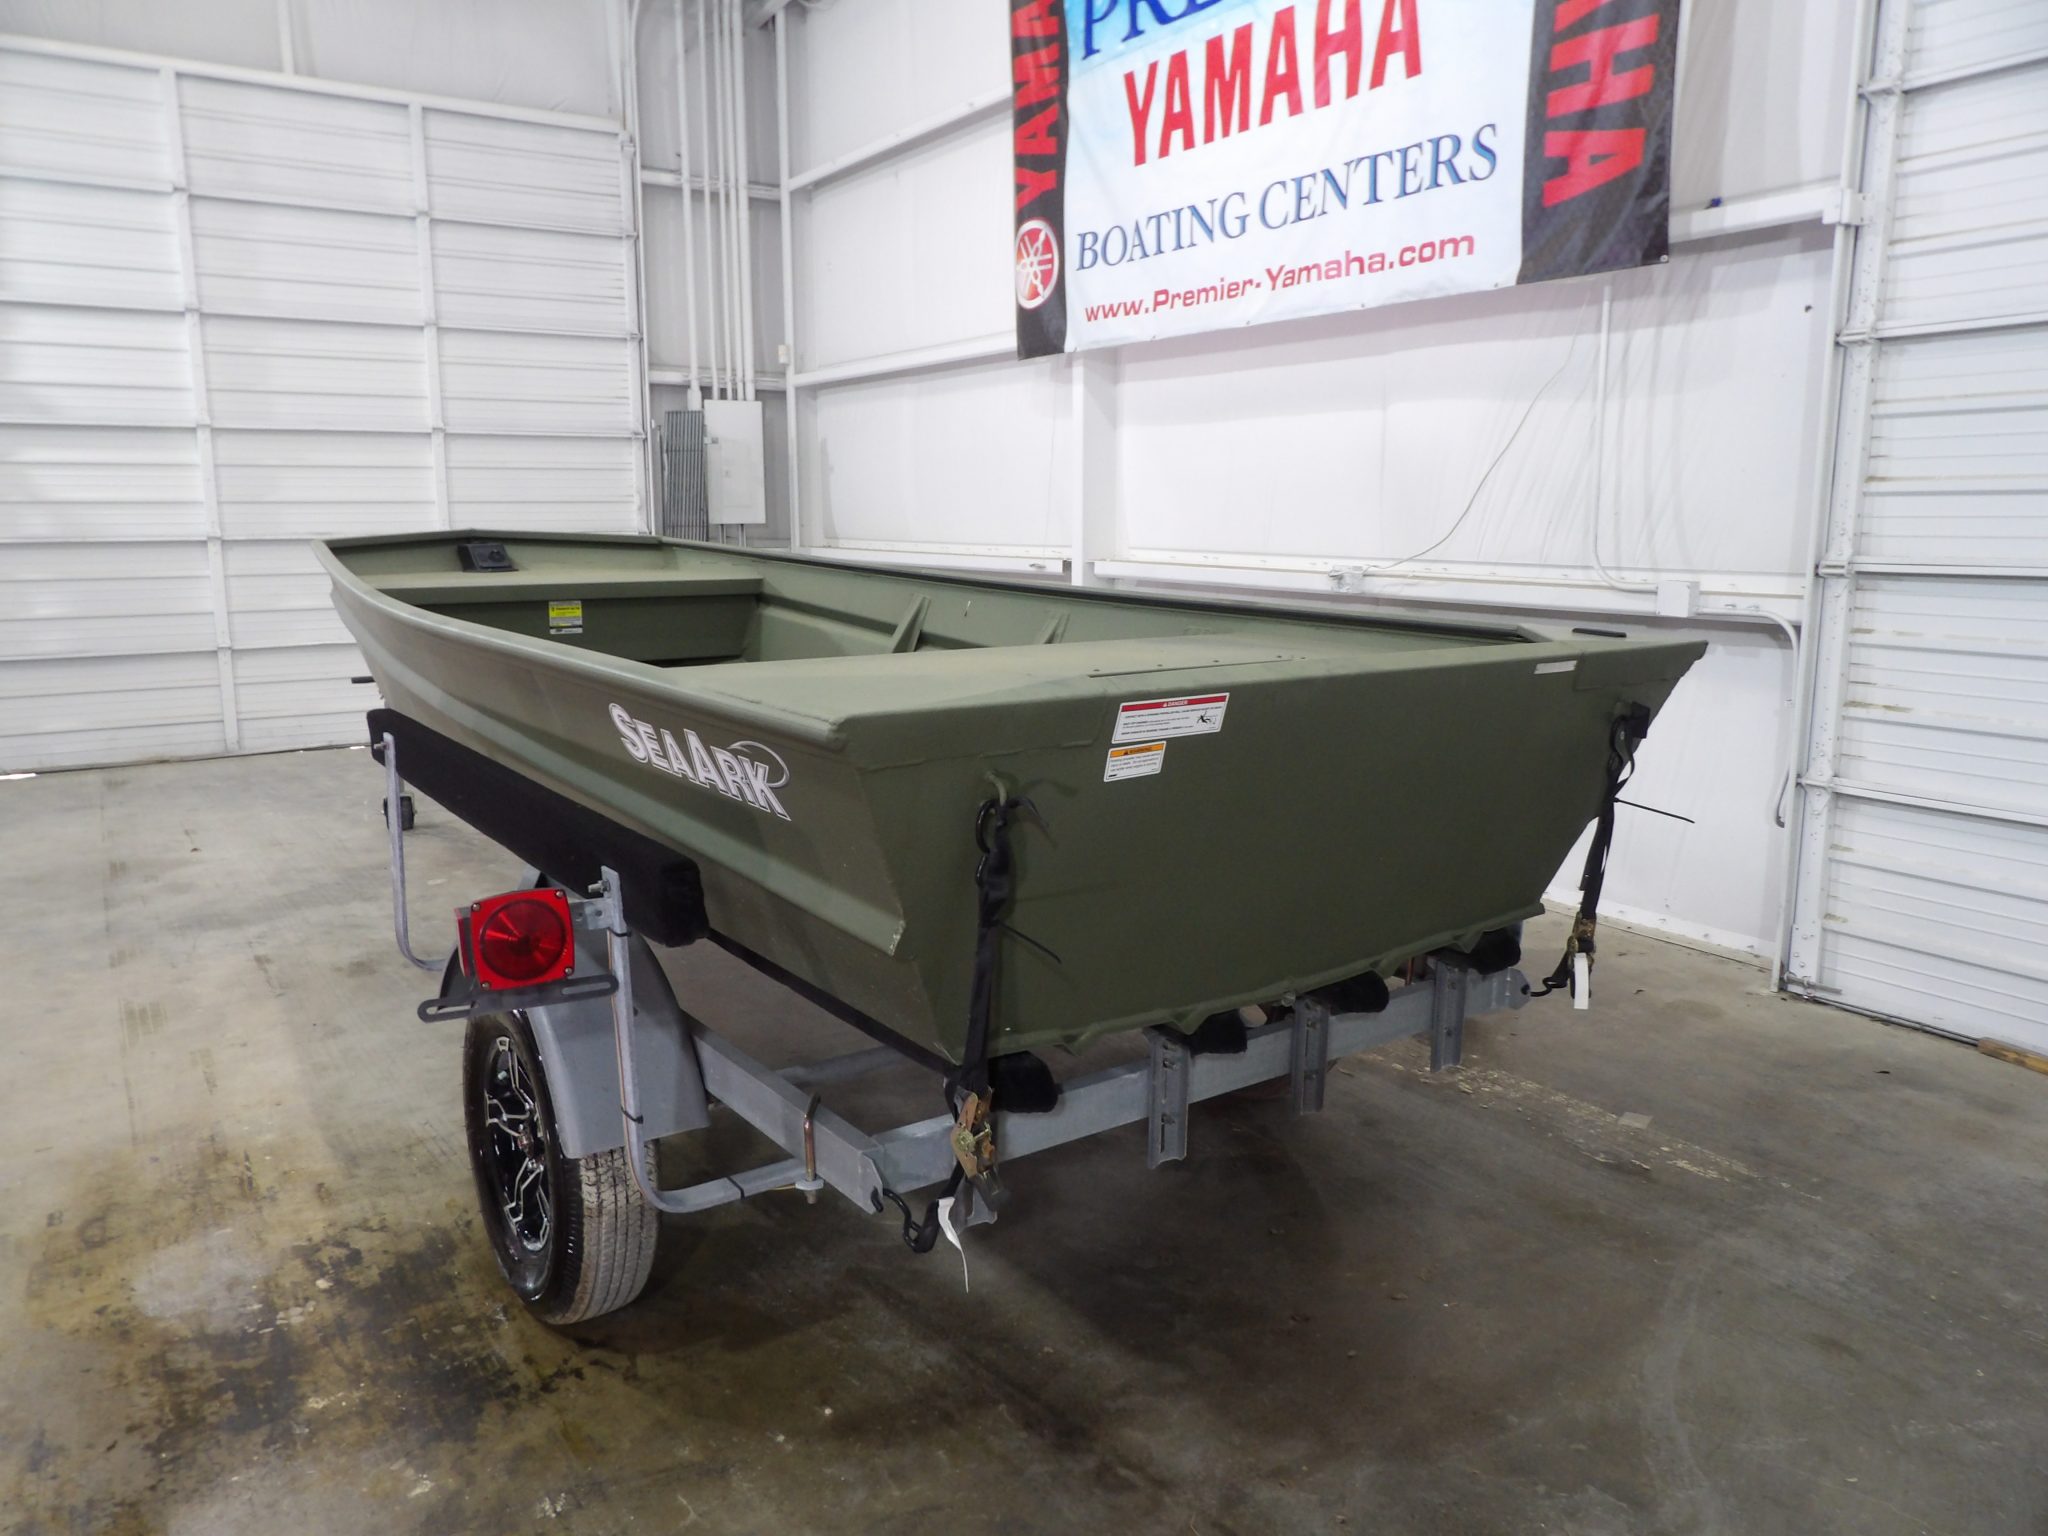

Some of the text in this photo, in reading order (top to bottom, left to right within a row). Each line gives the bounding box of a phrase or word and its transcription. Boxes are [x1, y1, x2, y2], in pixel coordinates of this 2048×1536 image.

[1123, 0, 1422, 167] YAMAHA
[1076, 123, 1498, 271] BOATING CENTERS
[1084, 234, 1475, 322] www.Premier-Yamaha.com
